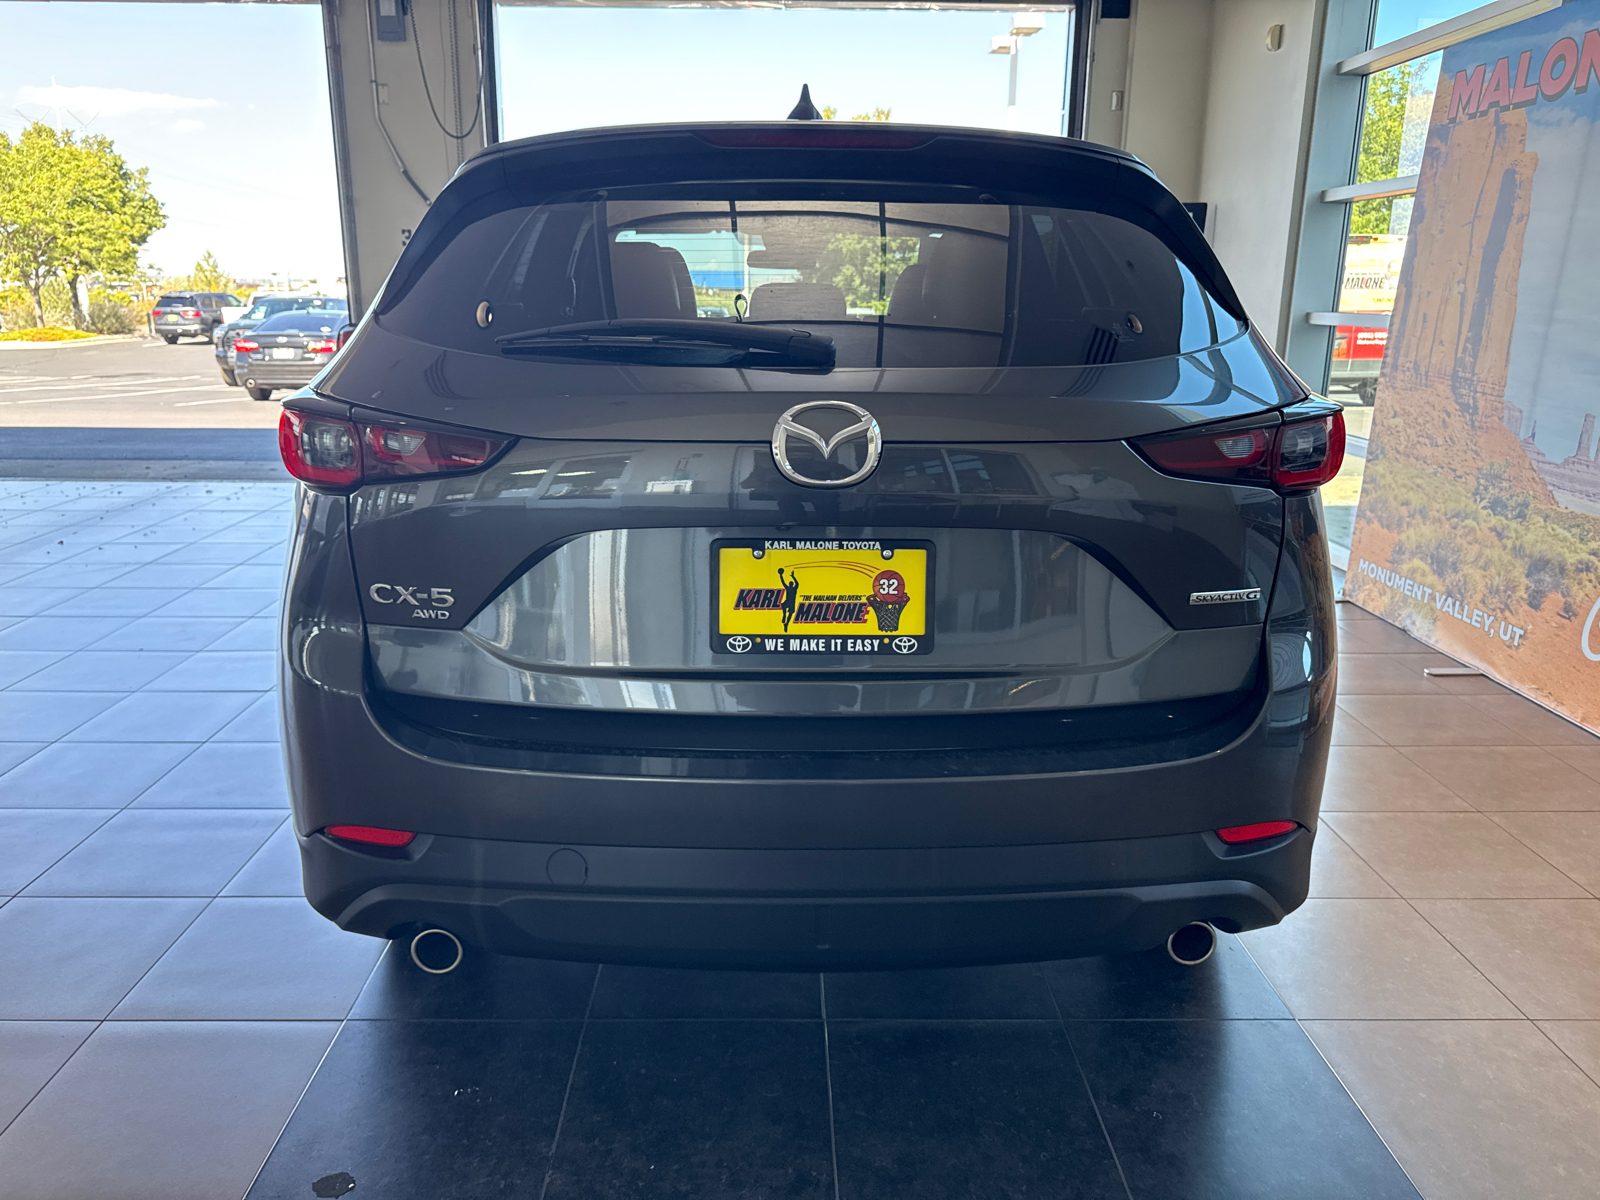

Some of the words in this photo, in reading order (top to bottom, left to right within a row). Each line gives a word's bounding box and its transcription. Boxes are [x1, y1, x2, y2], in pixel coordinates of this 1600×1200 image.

[1344, 277, 1386, 290] MALONE
[764, 540, 793, 550] KARL
[795, 541, 840, 550] MALONE
[842, 541, 882, 551] TOYOTA
[879, 578, 899, 595] 32
[369, 582, 456, 608] CX-5
[733, 588, 786, 611] KARL
[813, 594, 838, 602] MAILMAN
[1358, 558, 1433, 604] MONUMENT
[1435, 591, 1495, 638] VALLEY,
[1499, 620, 1525, 647] UT
[411, 608, 450, 620] AWD
[792, 601, 870, 624] MALONE
[764, 638, 785, 651] WE
[789, 638, 828, 652] MAKE
[830, 638, 844, 652] IT
[847, 639, 880, 652] EASY
